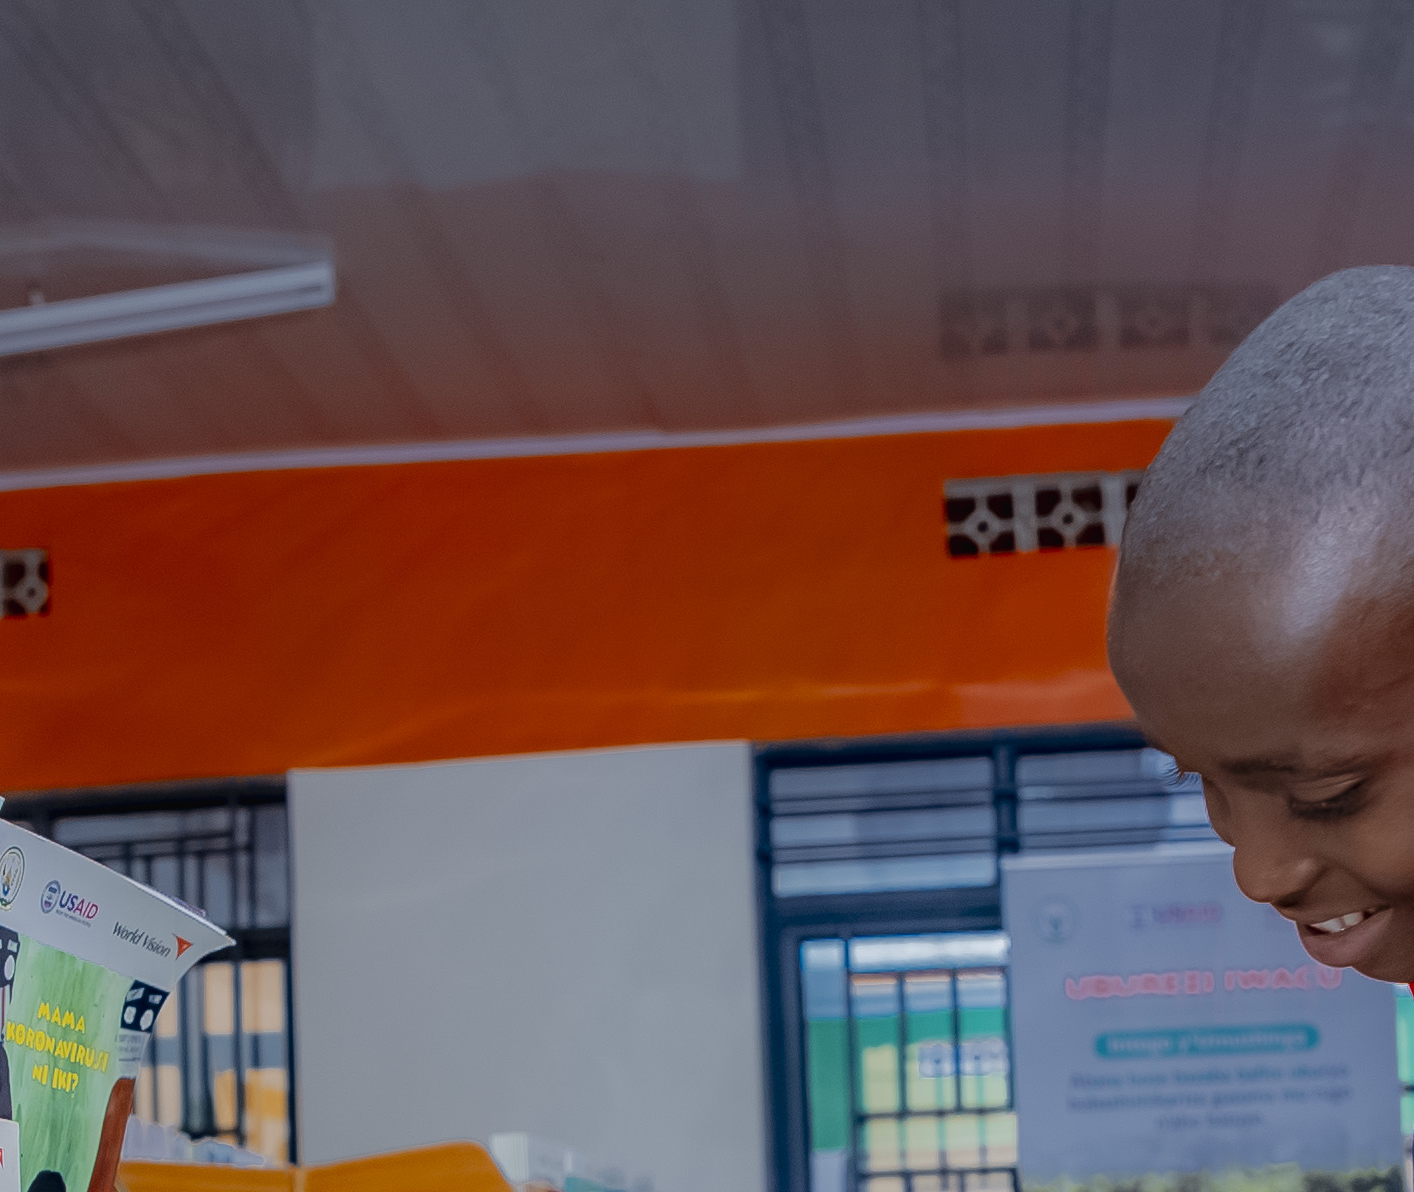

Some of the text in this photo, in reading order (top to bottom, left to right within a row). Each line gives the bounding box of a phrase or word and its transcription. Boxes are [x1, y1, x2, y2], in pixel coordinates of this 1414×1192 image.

[59, 890, 99, 920] USAID
[112, 921, 172, 957] World Vision
[37, 1001, 86, 1034] MAMA
[6, 1021, 110, 1073] KORONAVIRUSI
[51, 1066, 80, 1093] IKI?
